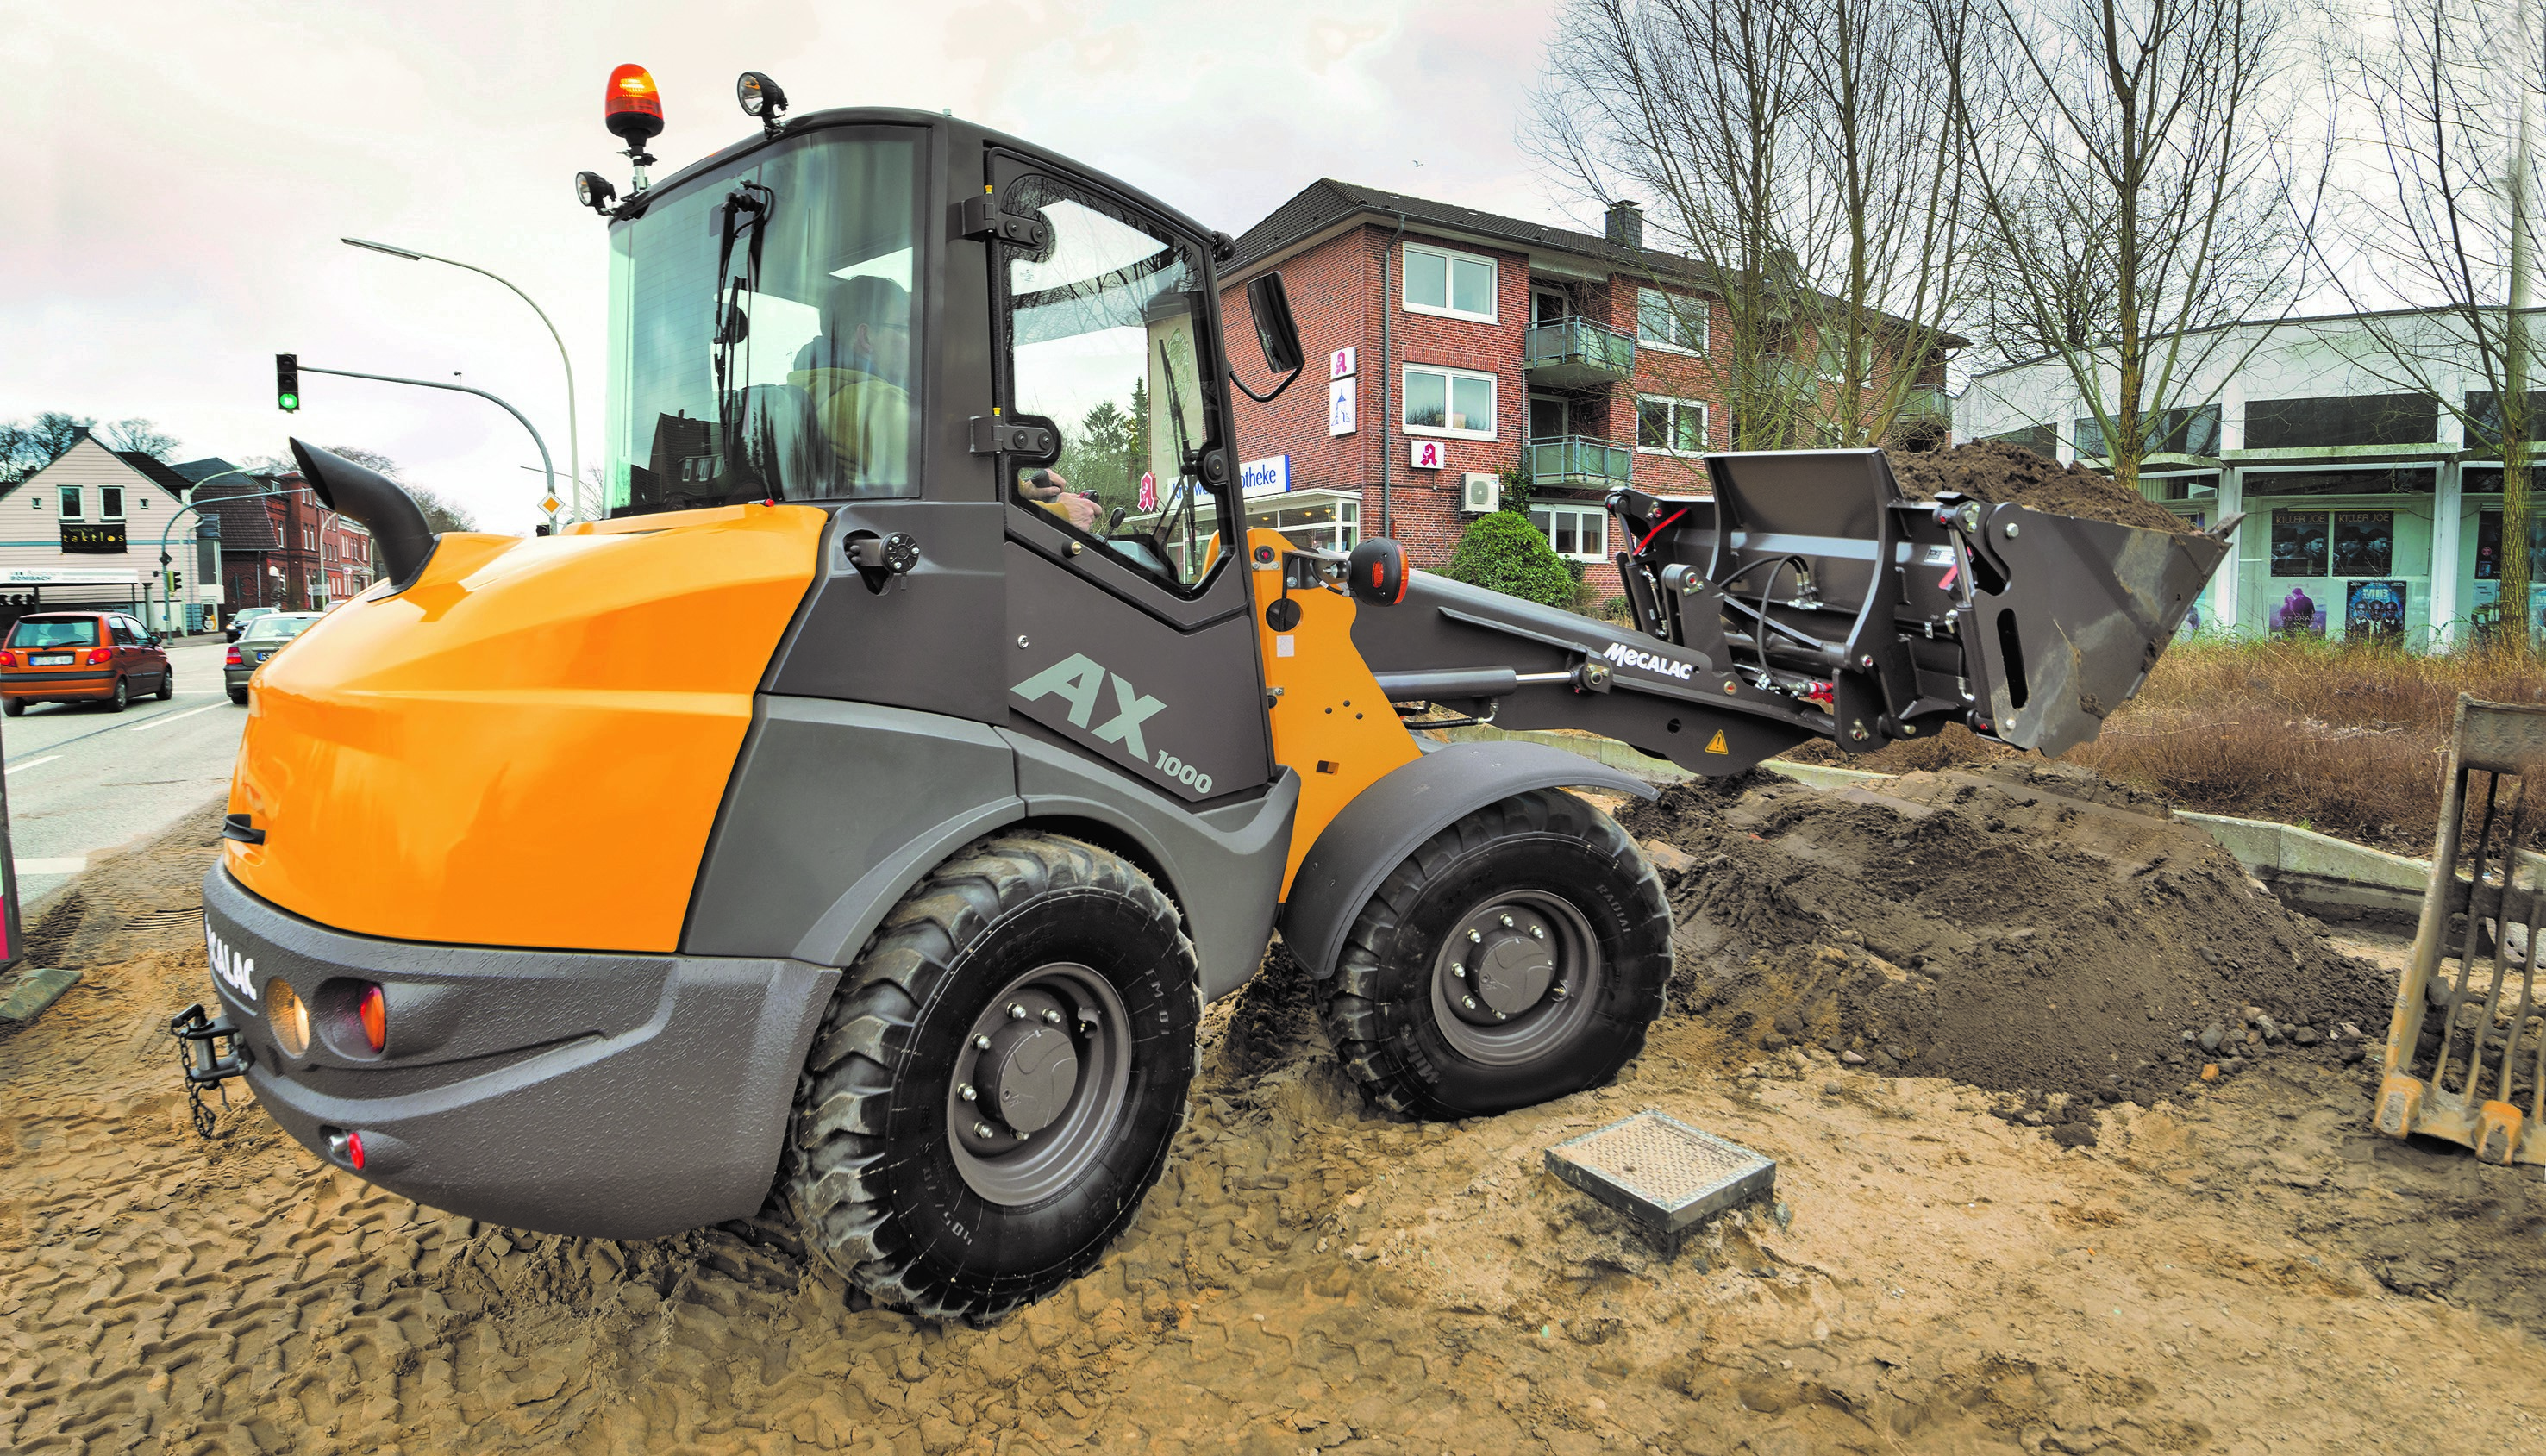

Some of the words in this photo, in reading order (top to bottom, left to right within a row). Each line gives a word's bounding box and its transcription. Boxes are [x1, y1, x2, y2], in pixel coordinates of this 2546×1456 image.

[2275, 515, 2305, 524] KILLER
[2307, 514, 2325, 523] JOE
[2338, 514, 2369, 522] KILLER
[2371, 513, 2390, 522] JOE
[63, 531, 124, 543] taktlos
[1010, 653, 1167, 764] AX
[1155, 749, 1213, 794] 1000
